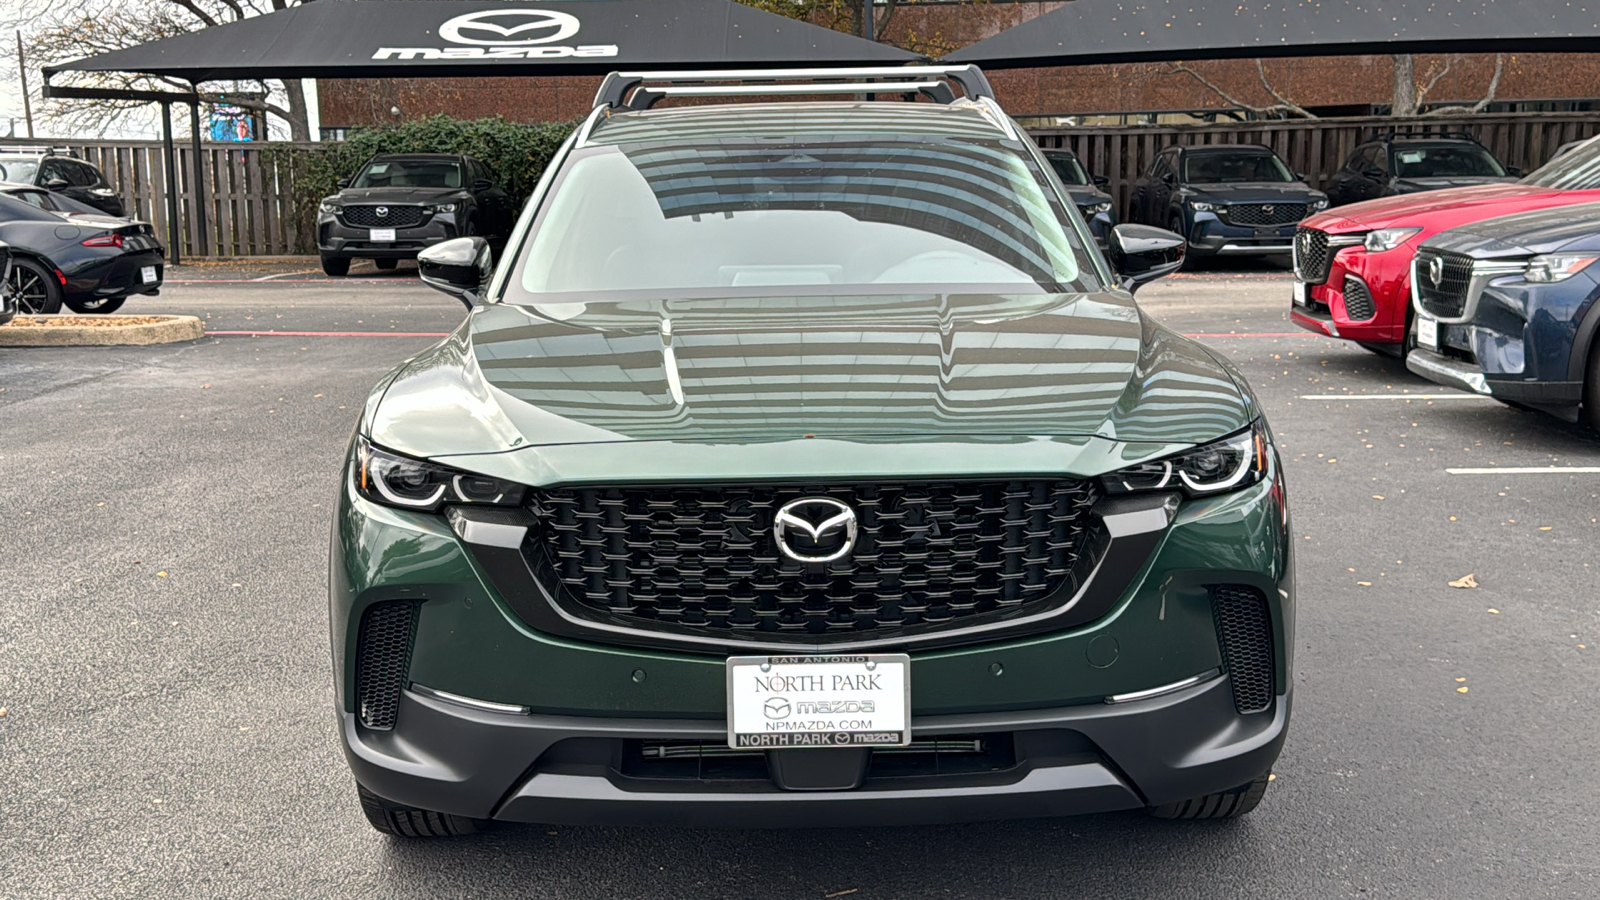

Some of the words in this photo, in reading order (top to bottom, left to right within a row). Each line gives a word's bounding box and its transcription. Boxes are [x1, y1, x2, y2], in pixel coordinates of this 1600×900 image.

[804, 656, 866, 664] ANTONIO
[754, 674, 825, 693] NORTH
[832, 674, 882, 691] PARK
[765, 720, 873, 731] NPMAZDA.COM
[739, 733, 789, 746] NORTH
[793, 732, 831, 745] PARK
